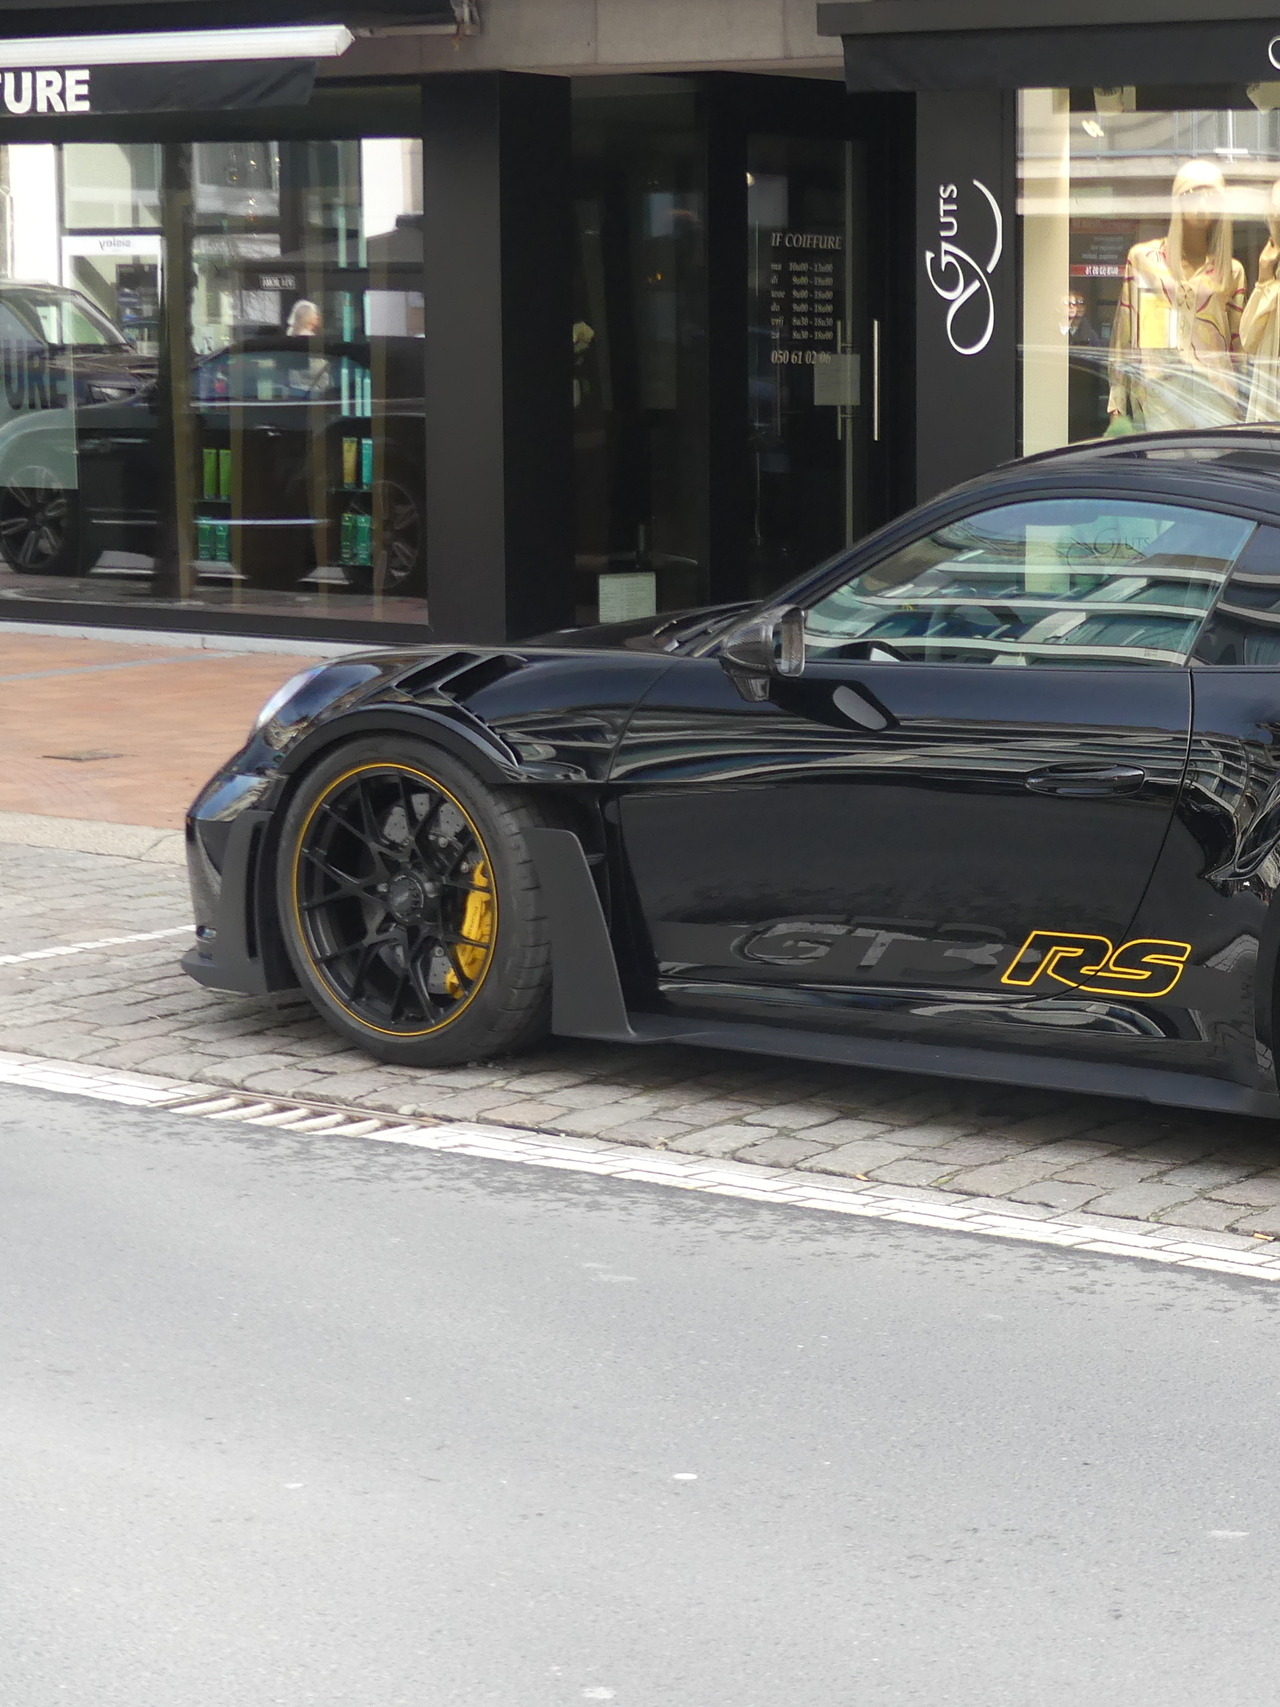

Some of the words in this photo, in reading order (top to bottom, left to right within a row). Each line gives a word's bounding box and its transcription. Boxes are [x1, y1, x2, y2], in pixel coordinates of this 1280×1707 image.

[0, 69, 90, 114] URE
[771, 233, 783, 247] IF
[785, 234, 842, 250] COIFFURE
[771, 350, 789, 364] 050
[791, 350, 803, 364] 61
[805, 350, 817, 364] 02
[1000, 930, 1193, 998] RS
